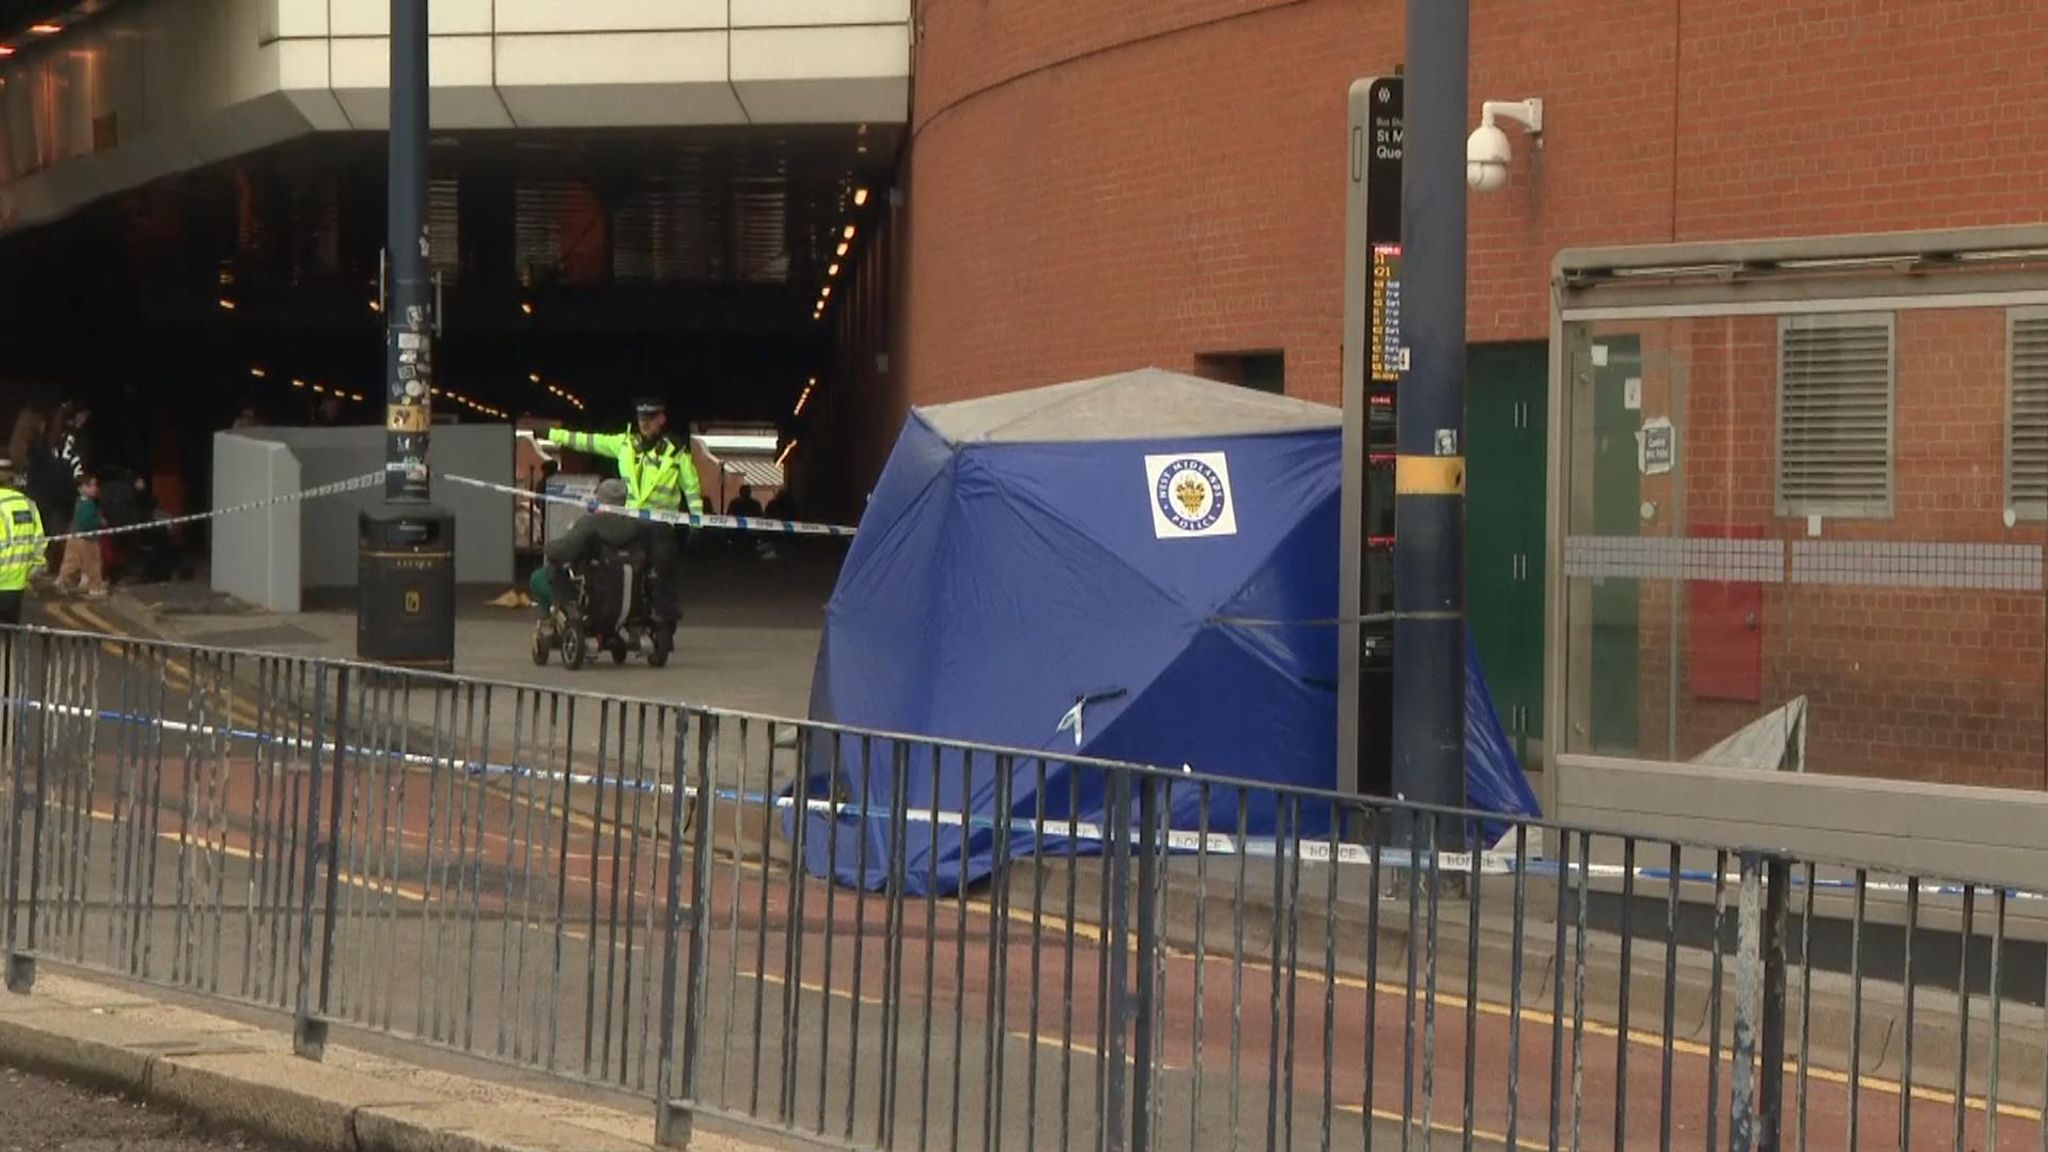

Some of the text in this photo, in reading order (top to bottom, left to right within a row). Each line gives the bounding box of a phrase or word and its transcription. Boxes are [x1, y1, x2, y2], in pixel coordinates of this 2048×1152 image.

[1376, 129, 1389, 142] St
[1159, 461, 1223, 499] WEST MIDLANDS
[1171, 514, 1217, 530] POLICE
